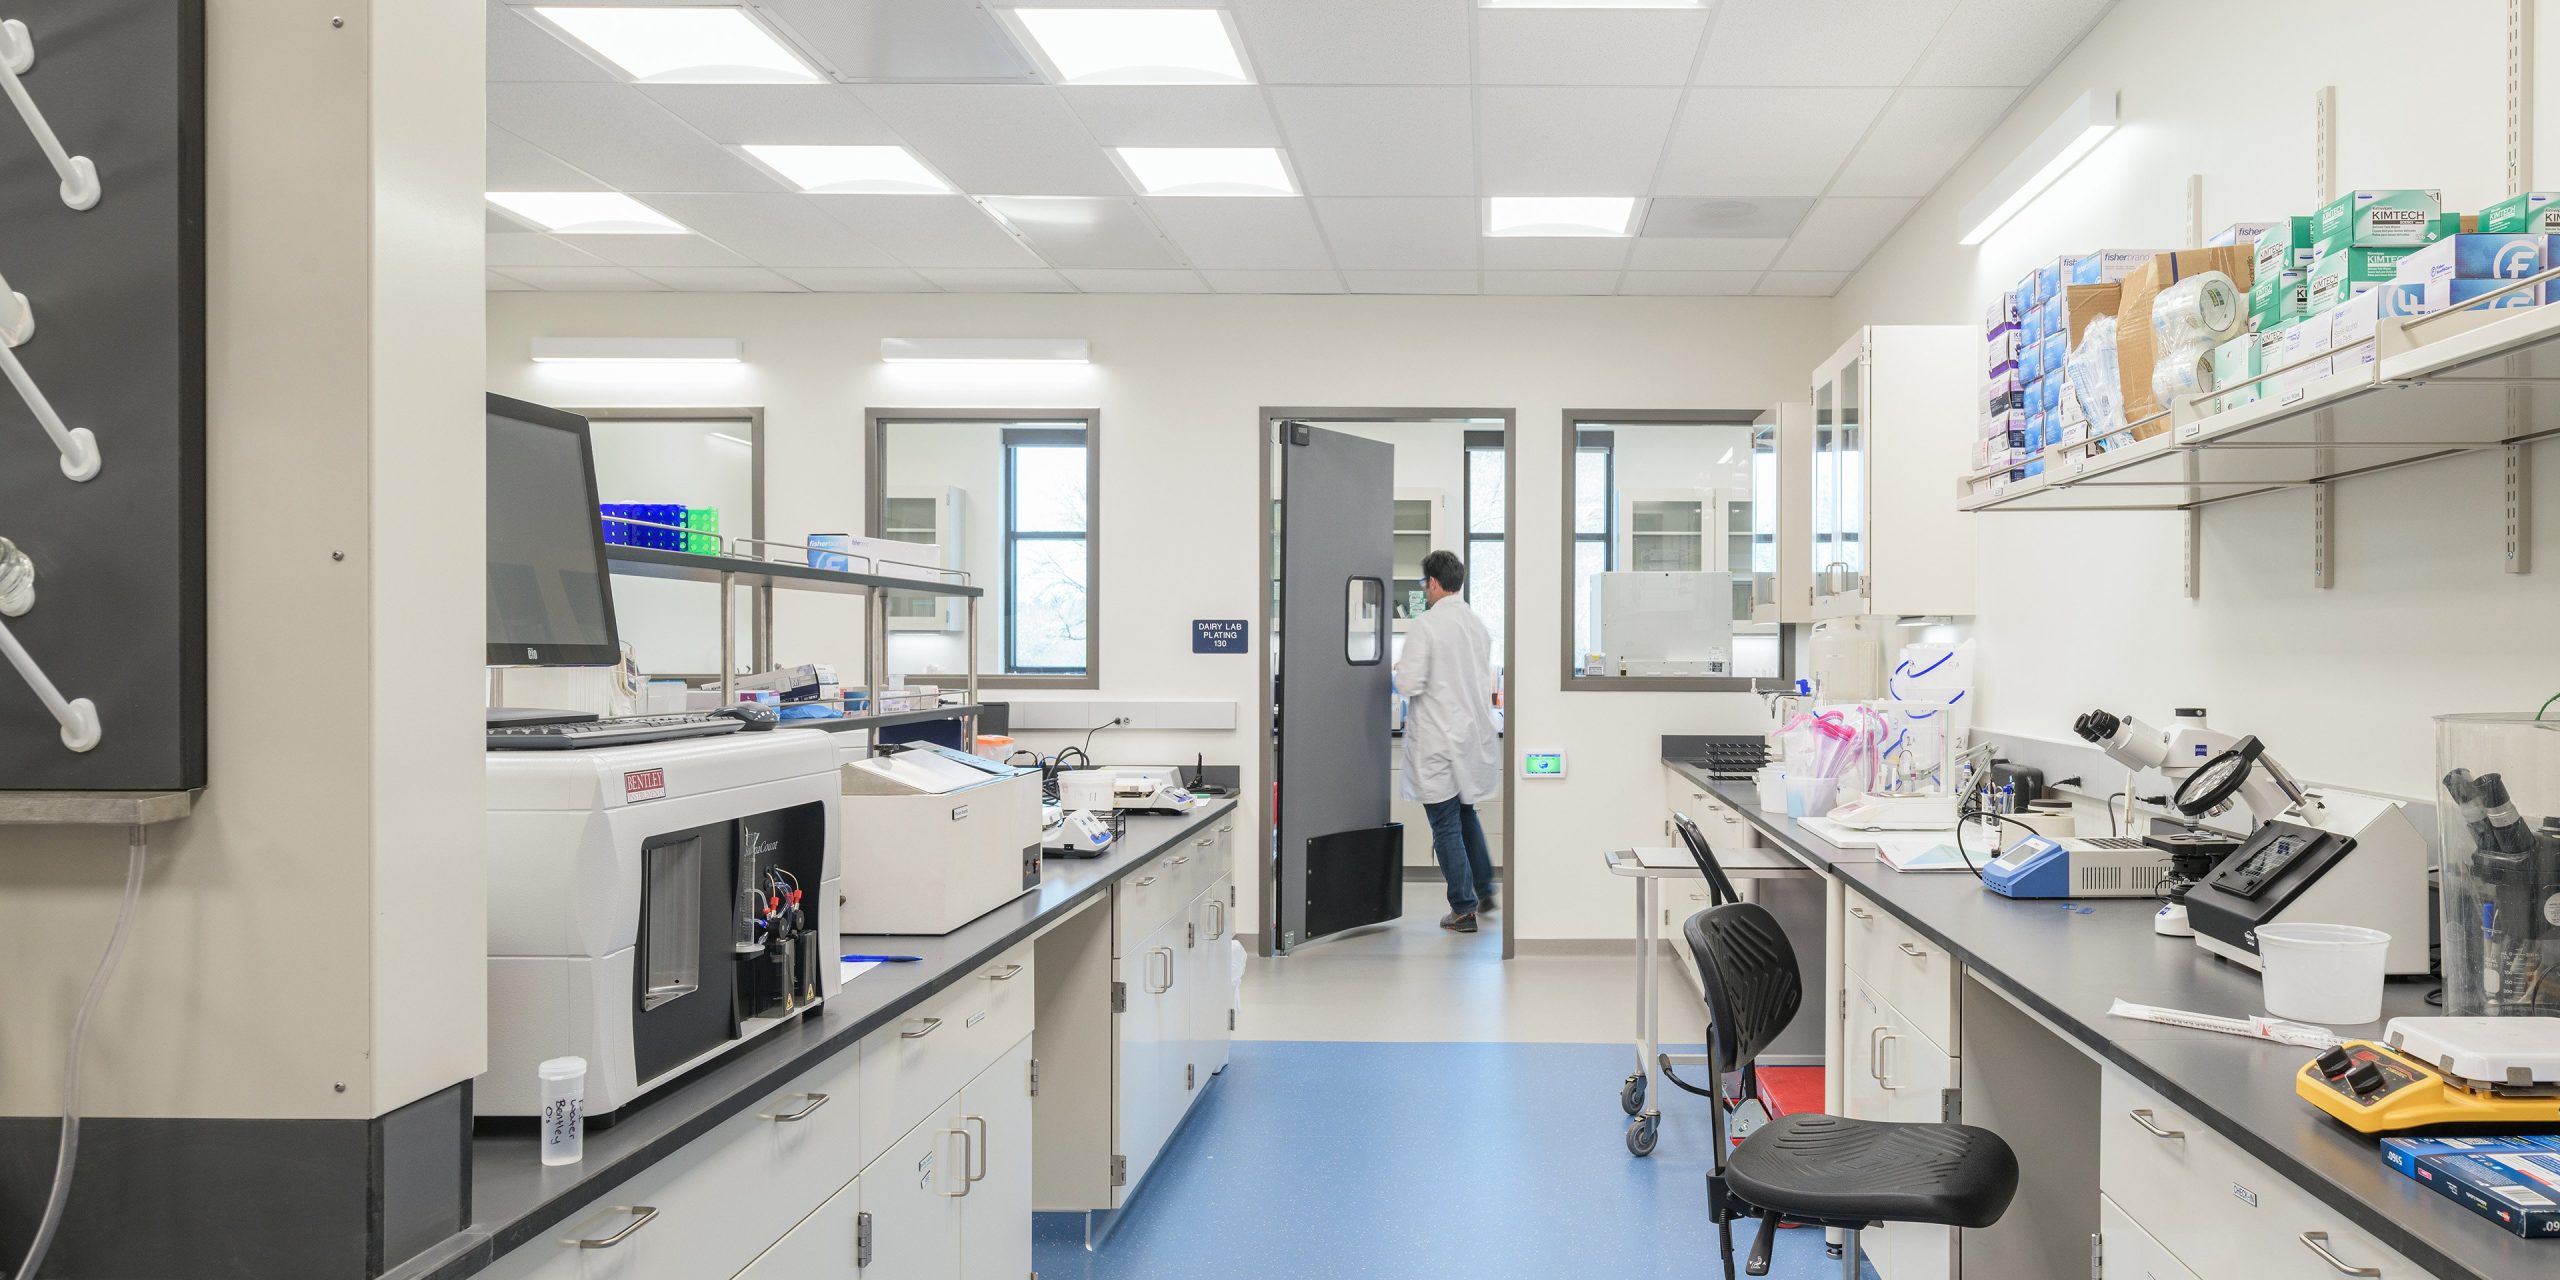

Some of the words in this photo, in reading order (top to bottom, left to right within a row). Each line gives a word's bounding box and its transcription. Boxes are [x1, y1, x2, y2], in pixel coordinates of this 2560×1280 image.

[2372, 211, 2425, 220] KIMTECH
[2239, 227, 2263, 236] fisher
[2260, 241, 2284, 258] KIMTECH
[2367, 255, 2406, 263] KIMTEC
[2313, 273, 2339, 290] KIMTECH
[1198, 622, 1223, 631] DAIRY
[1225, 623, 1242, 631] LAB
[1203, 631, 1238, 639] PLATING
[627, 771, 663, 791] BENTLEY
[550, 1098, 567, 1146] Bentley
